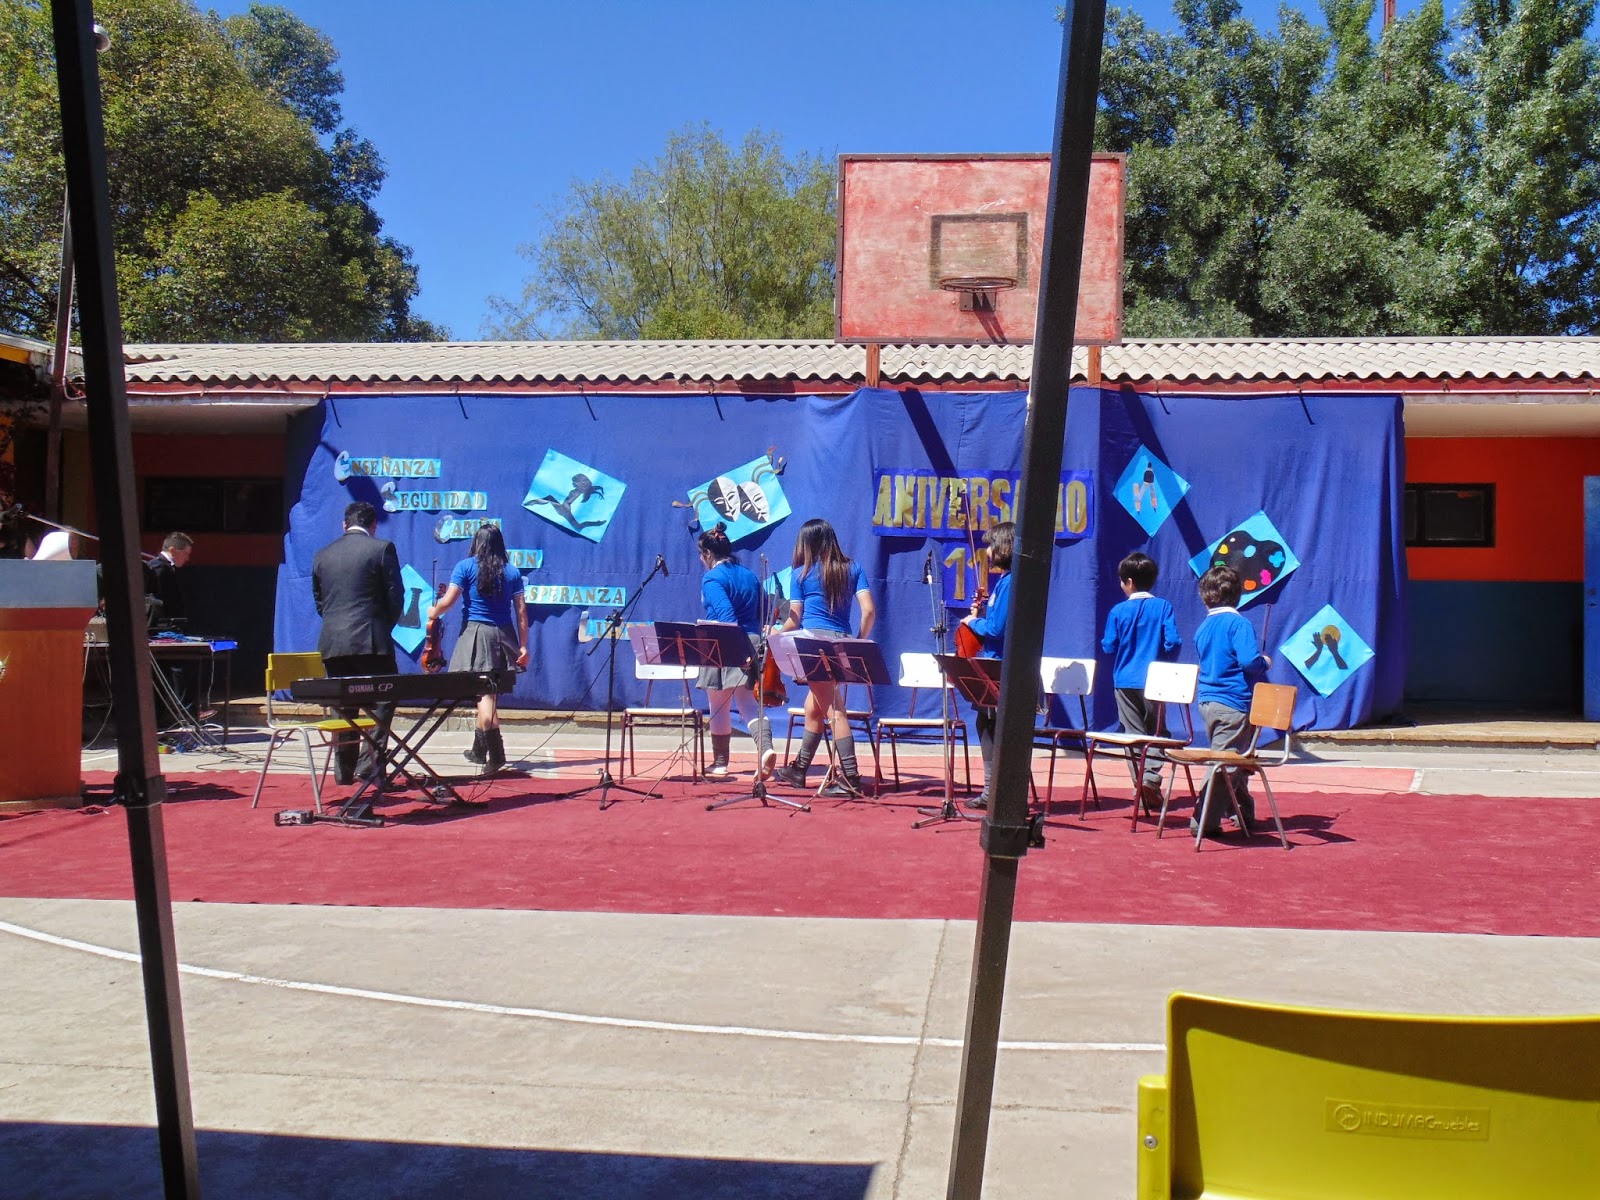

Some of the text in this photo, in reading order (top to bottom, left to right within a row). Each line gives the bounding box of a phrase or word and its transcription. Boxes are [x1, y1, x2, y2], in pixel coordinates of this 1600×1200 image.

[381, 481, 485, 512] SEGURIDAD
[872, 474, 1088, 534] ANIVERSIO
[521, 576, 624, 605] SPERANZA
[378, 683, 394, 692] CP
